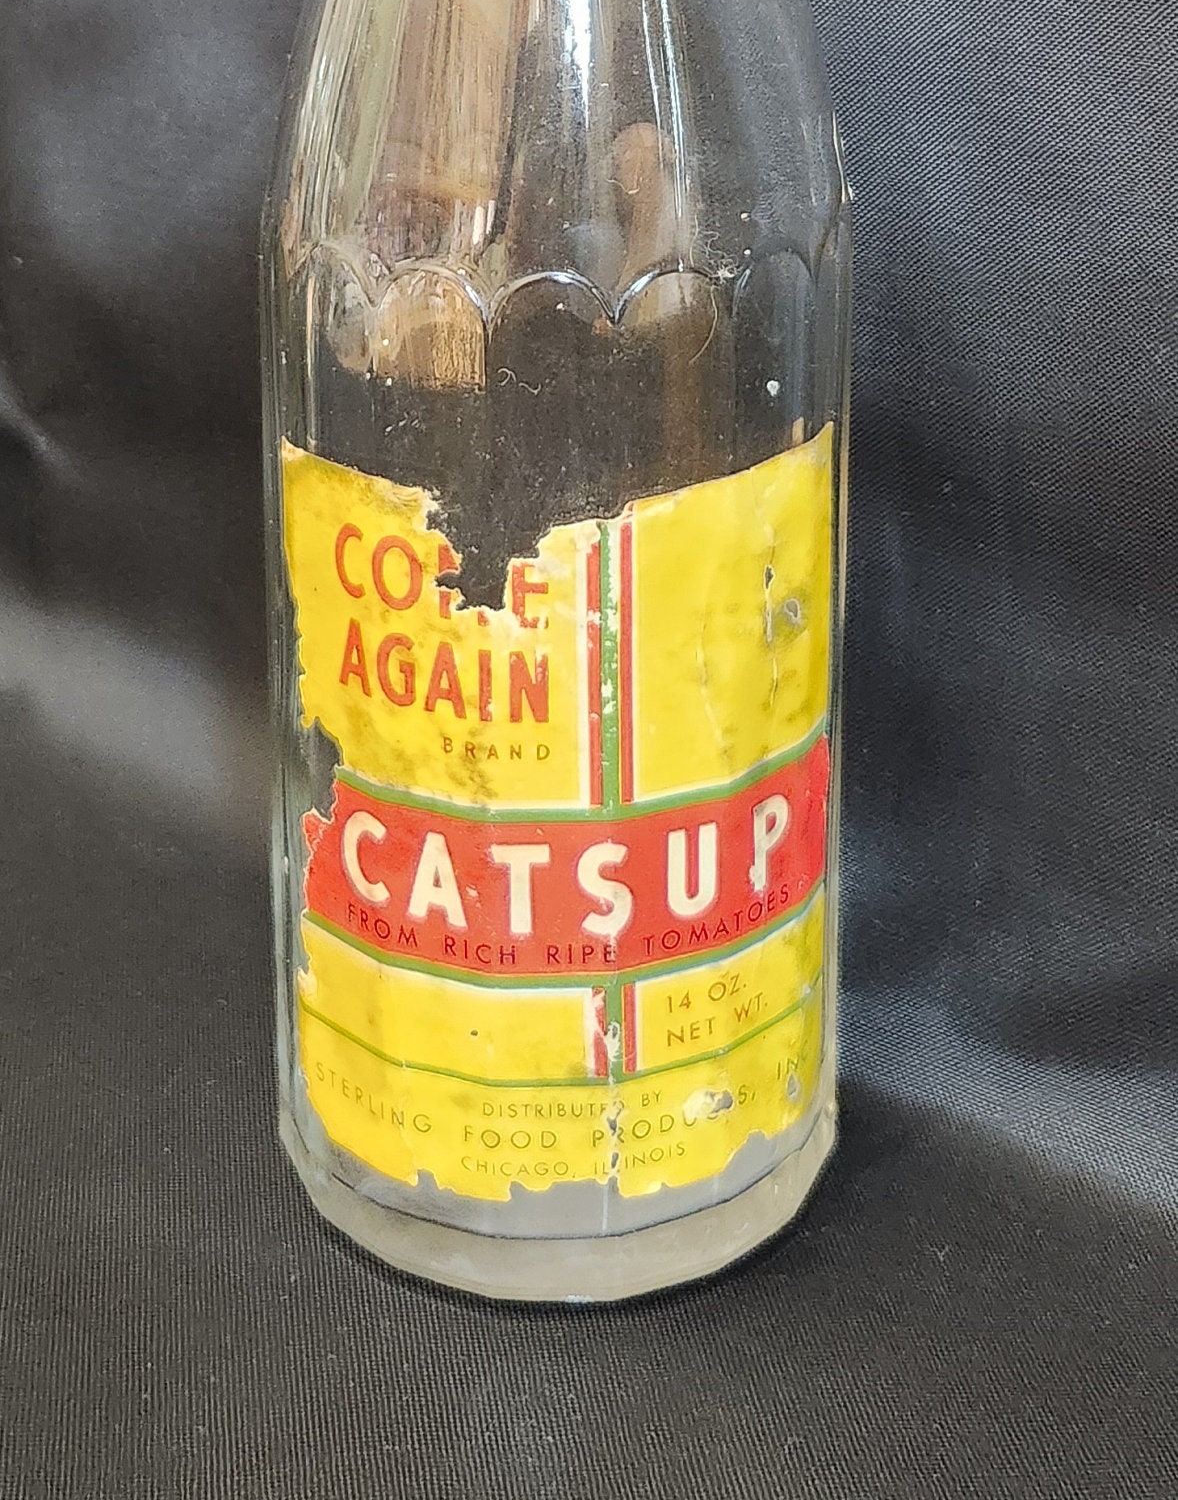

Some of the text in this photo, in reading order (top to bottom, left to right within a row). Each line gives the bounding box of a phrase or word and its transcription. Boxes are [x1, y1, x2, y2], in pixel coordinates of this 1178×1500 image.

[339, 617, 549, 723] AGAIN
[441, 736, 551, 761] BRAND
[341, 793, 789, 936] CATSUP
[348, 884, 789, 964] FROM RICH RIPE TOMATOES
[667, 973, 747, 1013] 14 OZ.
[667, 993, 768, 1047] NET WT.
[316, 1062, 432, 1133] STERLING
[464, 1125, 557, 1149] FOOD
[592, 1084, 756, 1148] PRODUS,
[641, 1090, 662, 1108] BY
[594, 1143, 685, 1175] ILINOIS
